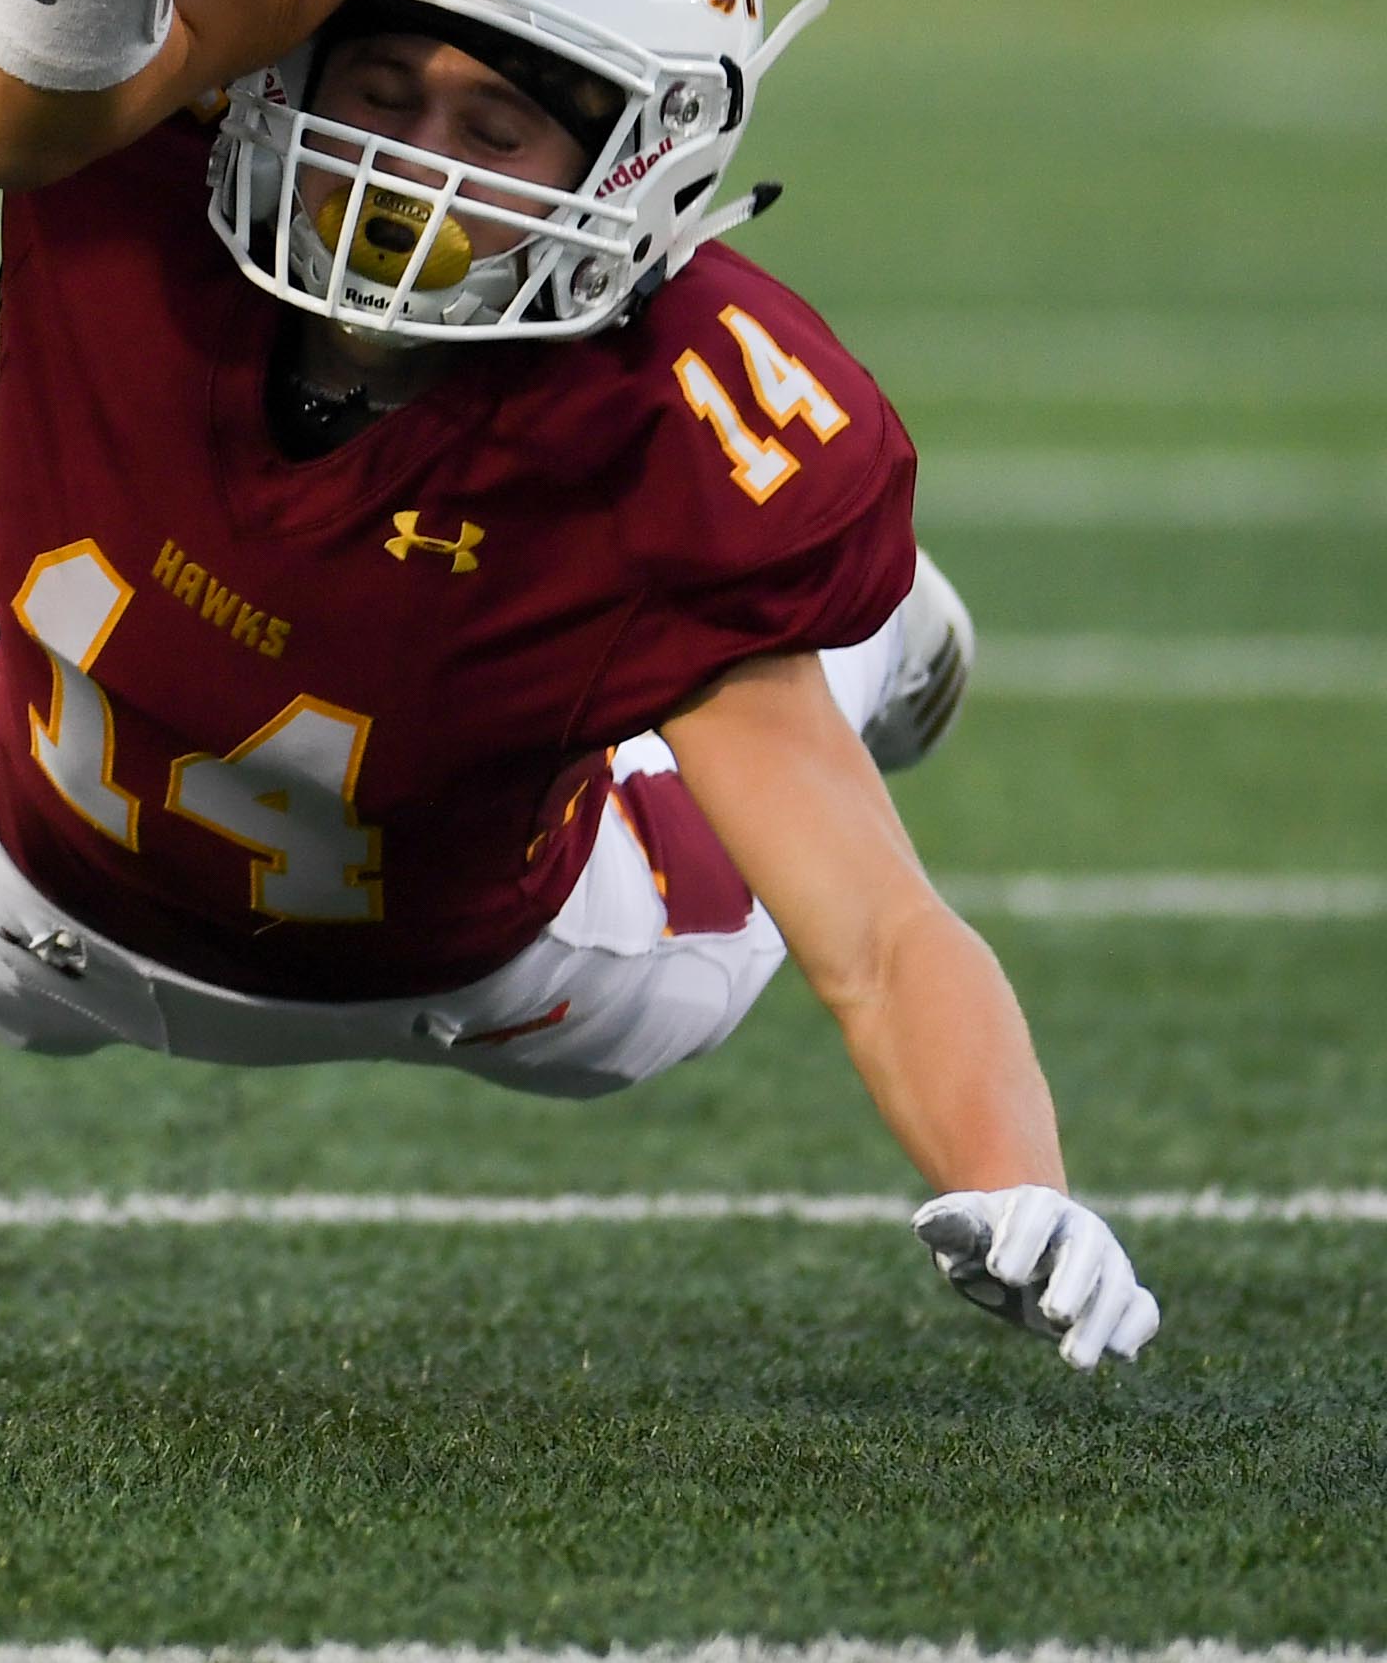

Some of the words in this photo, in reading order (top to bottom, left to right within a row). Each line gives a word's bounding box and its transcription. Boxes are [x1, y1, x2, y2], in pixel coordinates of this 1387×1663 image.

[672, 303, 851, 506] 14
[152, 539, 292, 659] HAWKS
[11, 538, 384, 923] 14
